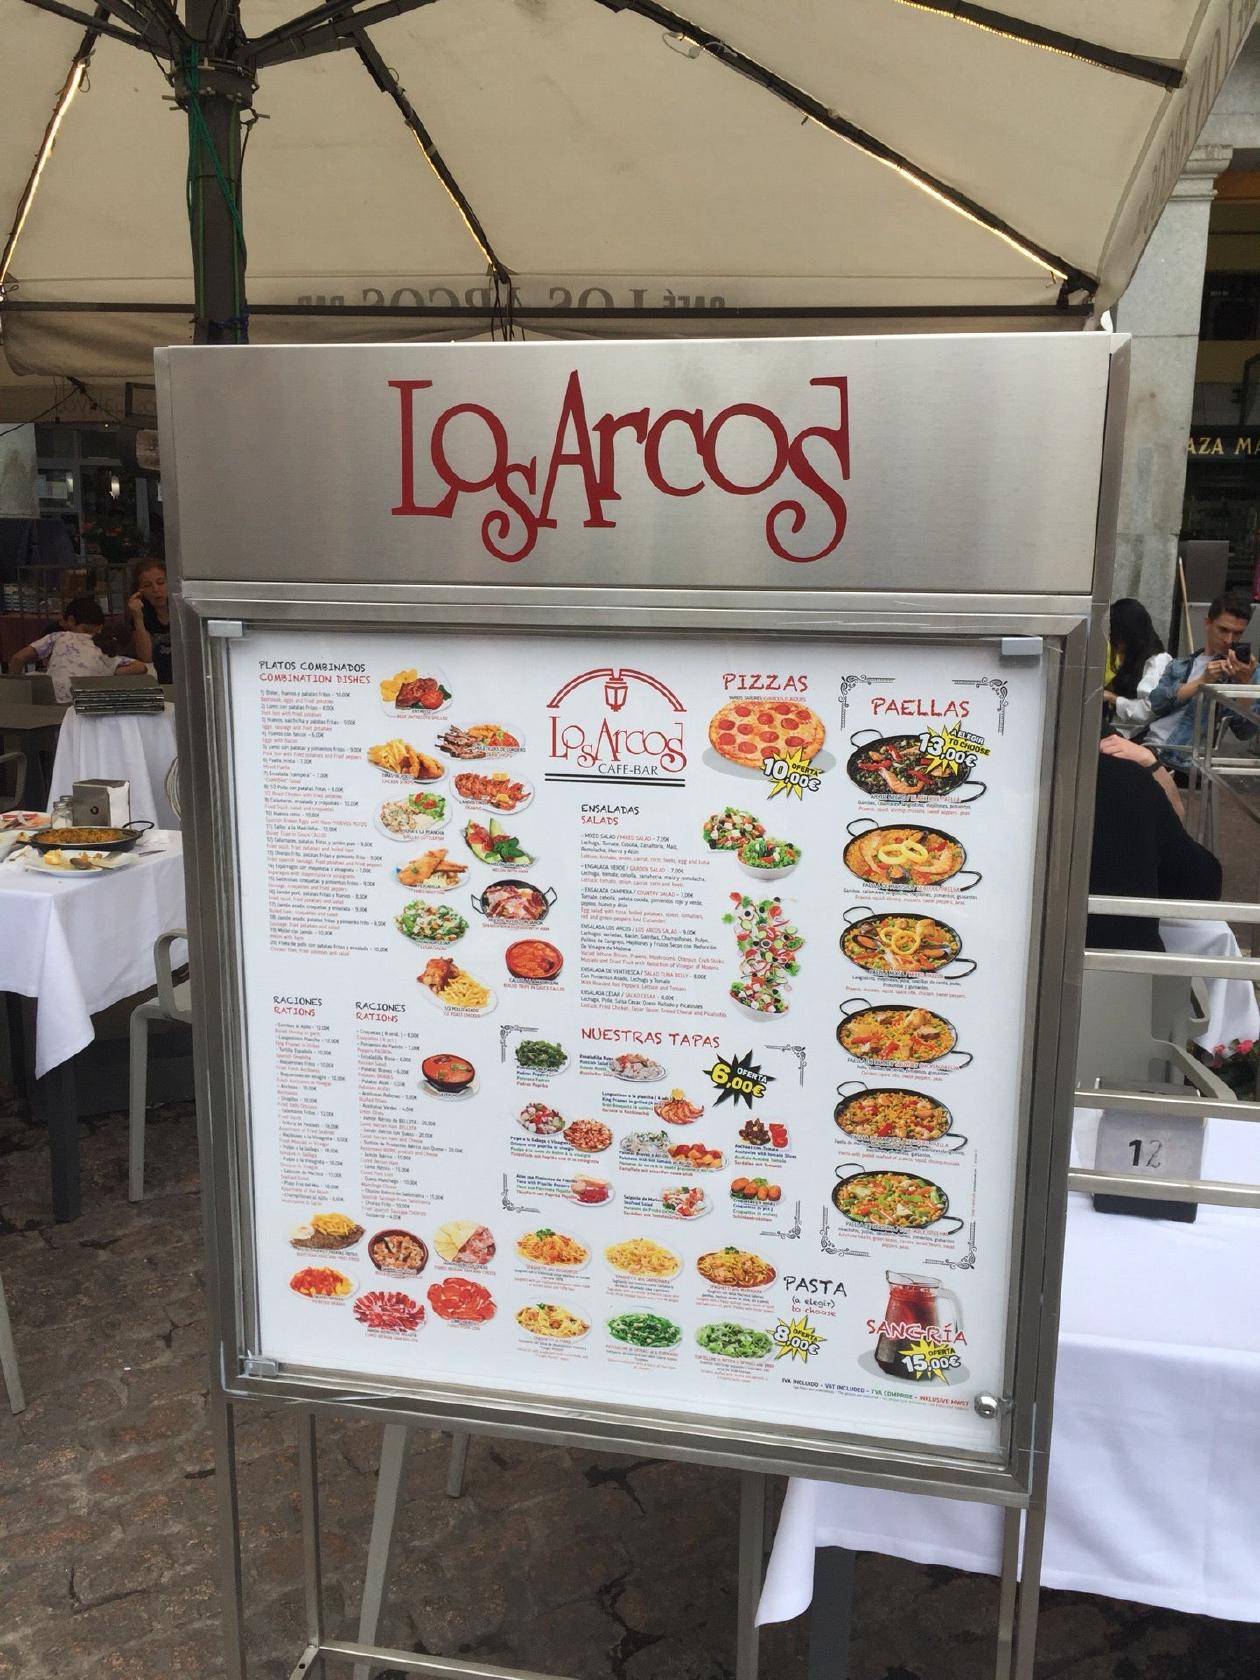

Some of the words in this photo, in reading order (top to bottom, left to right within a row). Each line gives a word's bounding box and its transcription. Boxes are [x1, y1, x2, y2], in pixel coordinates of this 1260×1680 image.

[259, 660, 296, 670] PLATOS
[300, 662, 366, 672] COMBINADOS
[259, 673, 332, 683] COMBINATION
[337, 675, 371, 684] DISHES
[722, 673, 808, 692] PIZZAS
[871, 697, 970, 718] PAELLAS
[957, 730, 985, 745] ELEGIR
[919, 732, 978, 768] 13,00€
[949, 738, 959, 747] TO
[960, 740, 990, 756] CHOOSE
[598, 763, 658, 775] CAFE-BAR
[763, 757, 821, 792] 10,00€
[792, 763, 818, 776] OFERTA
[581, 803, 640, 815] ENSALADAS
[581, 815, 619, 825] SALADS
[273, 995, 323, 1006] RACIONES
[355, 1001, 406, 1012] RACIONES
[273, 1006, 316, 1017] RATIONS
[356, 1012, 398, 1023] RATIONS
[581, 1027, 662, 1046] NUESTRAS
[668, 1032, 720, 1049] TAPAS
[710, 1062, 768, 1098] 6,00€
[737, 1067, 767, 1083] OFERTA
[1128, 1139, 1162, 1169] 12
[784, 1276, 848, 1297] PASTA
[791, 1305, 801, 1313] to
[804, 1306, 837, 1317] choose
[773, 1324, 821, 1356] 8,00€
[792, 1327, 819, 1342] OFERTA
[866, 1319, 968, 1346] SANGRÍA
[901, 1353, 962, 1373] 15,00€
[793, 1379, 819, 1388] INCLUIDO
[836, 1384, 865, 1393] INCLUDED
